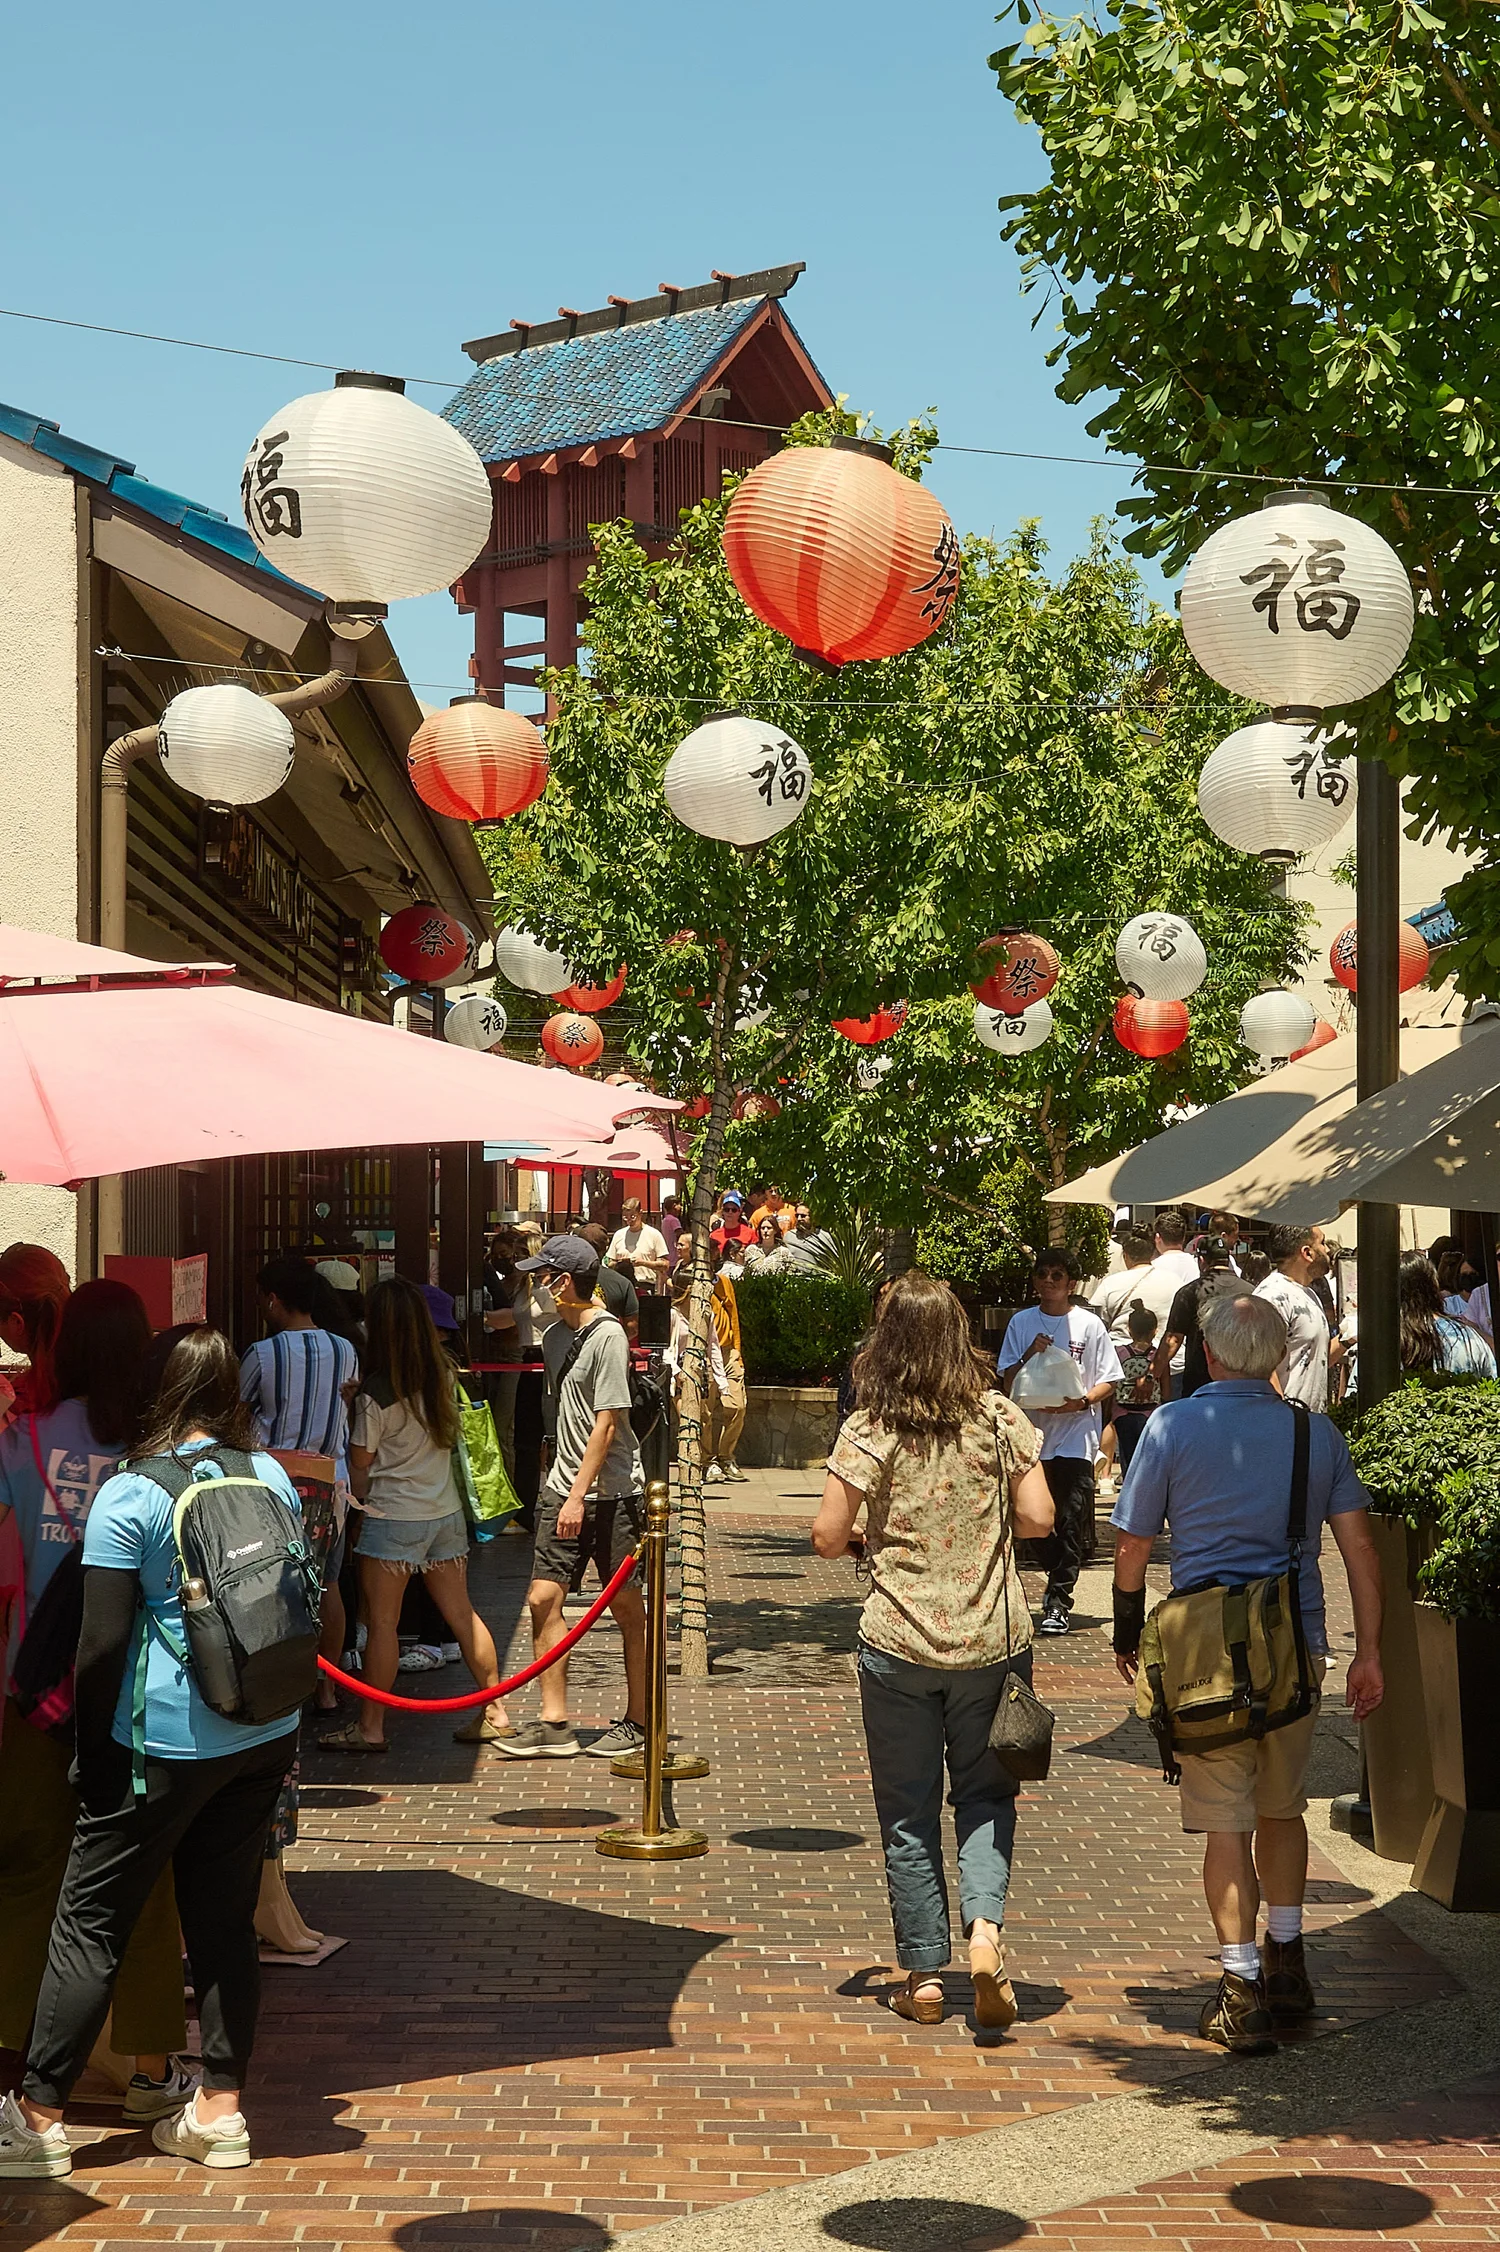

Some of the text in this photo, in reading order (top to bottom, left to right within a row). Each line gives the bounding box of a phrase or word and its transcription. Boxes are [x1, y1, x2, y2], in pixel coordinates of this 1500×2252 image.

[240, 430, 302, 546] 福
[1239, 532, 1360, 640] 福
[748, 739, 806, 807] 福
[1282, 733, 1349, 807] 福
[410, 918, 455, 957] 祭
[1138, 917, 1183, 962] 福
[1000, 957, 1048, 998] 祭
[479, 1005, 504, 1035] 福
[559, 1022, 591, 1048] 祭
